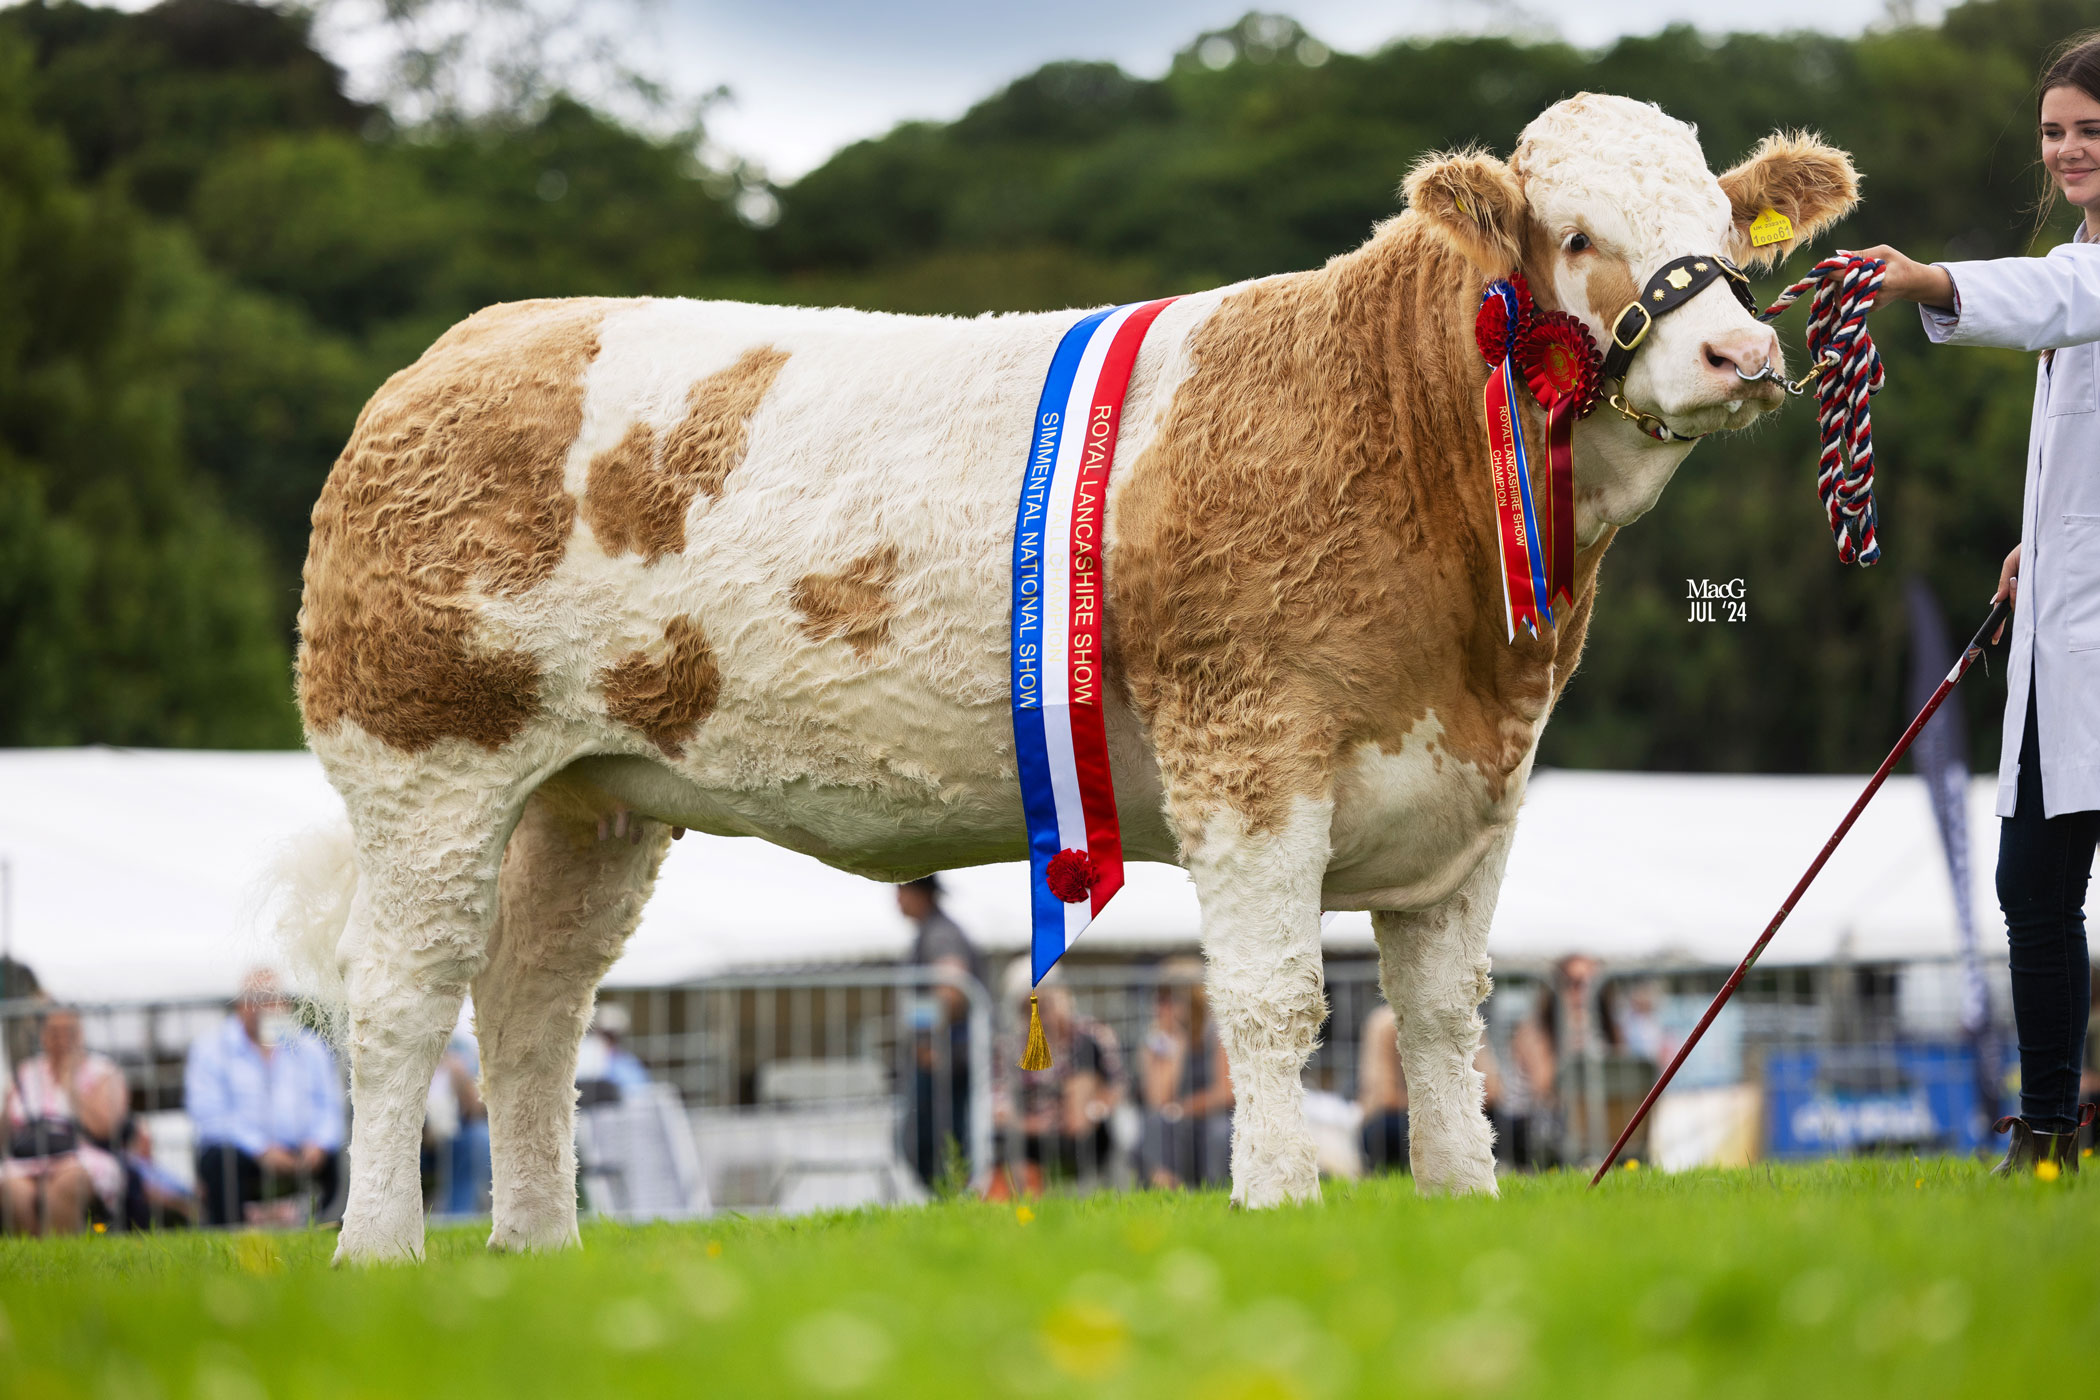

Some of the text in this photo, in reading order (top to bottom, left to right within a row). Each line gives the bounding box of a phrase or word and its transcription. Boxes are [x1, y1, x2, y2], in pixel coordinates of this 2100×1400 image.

[1019, 412, 1060, 711] SIMMENTAL NATIONAL SHOW
[1047, 459, 1076, 664] OVERALL CHAMPION
[1073, 405, 1113, 706] ROYAL LANCASHIRE SHOW
[1493, 449, 1508, 507] CHAMPION
[1499, 405, 1525, 546] ROYAL LANCASHIRE SHOW
